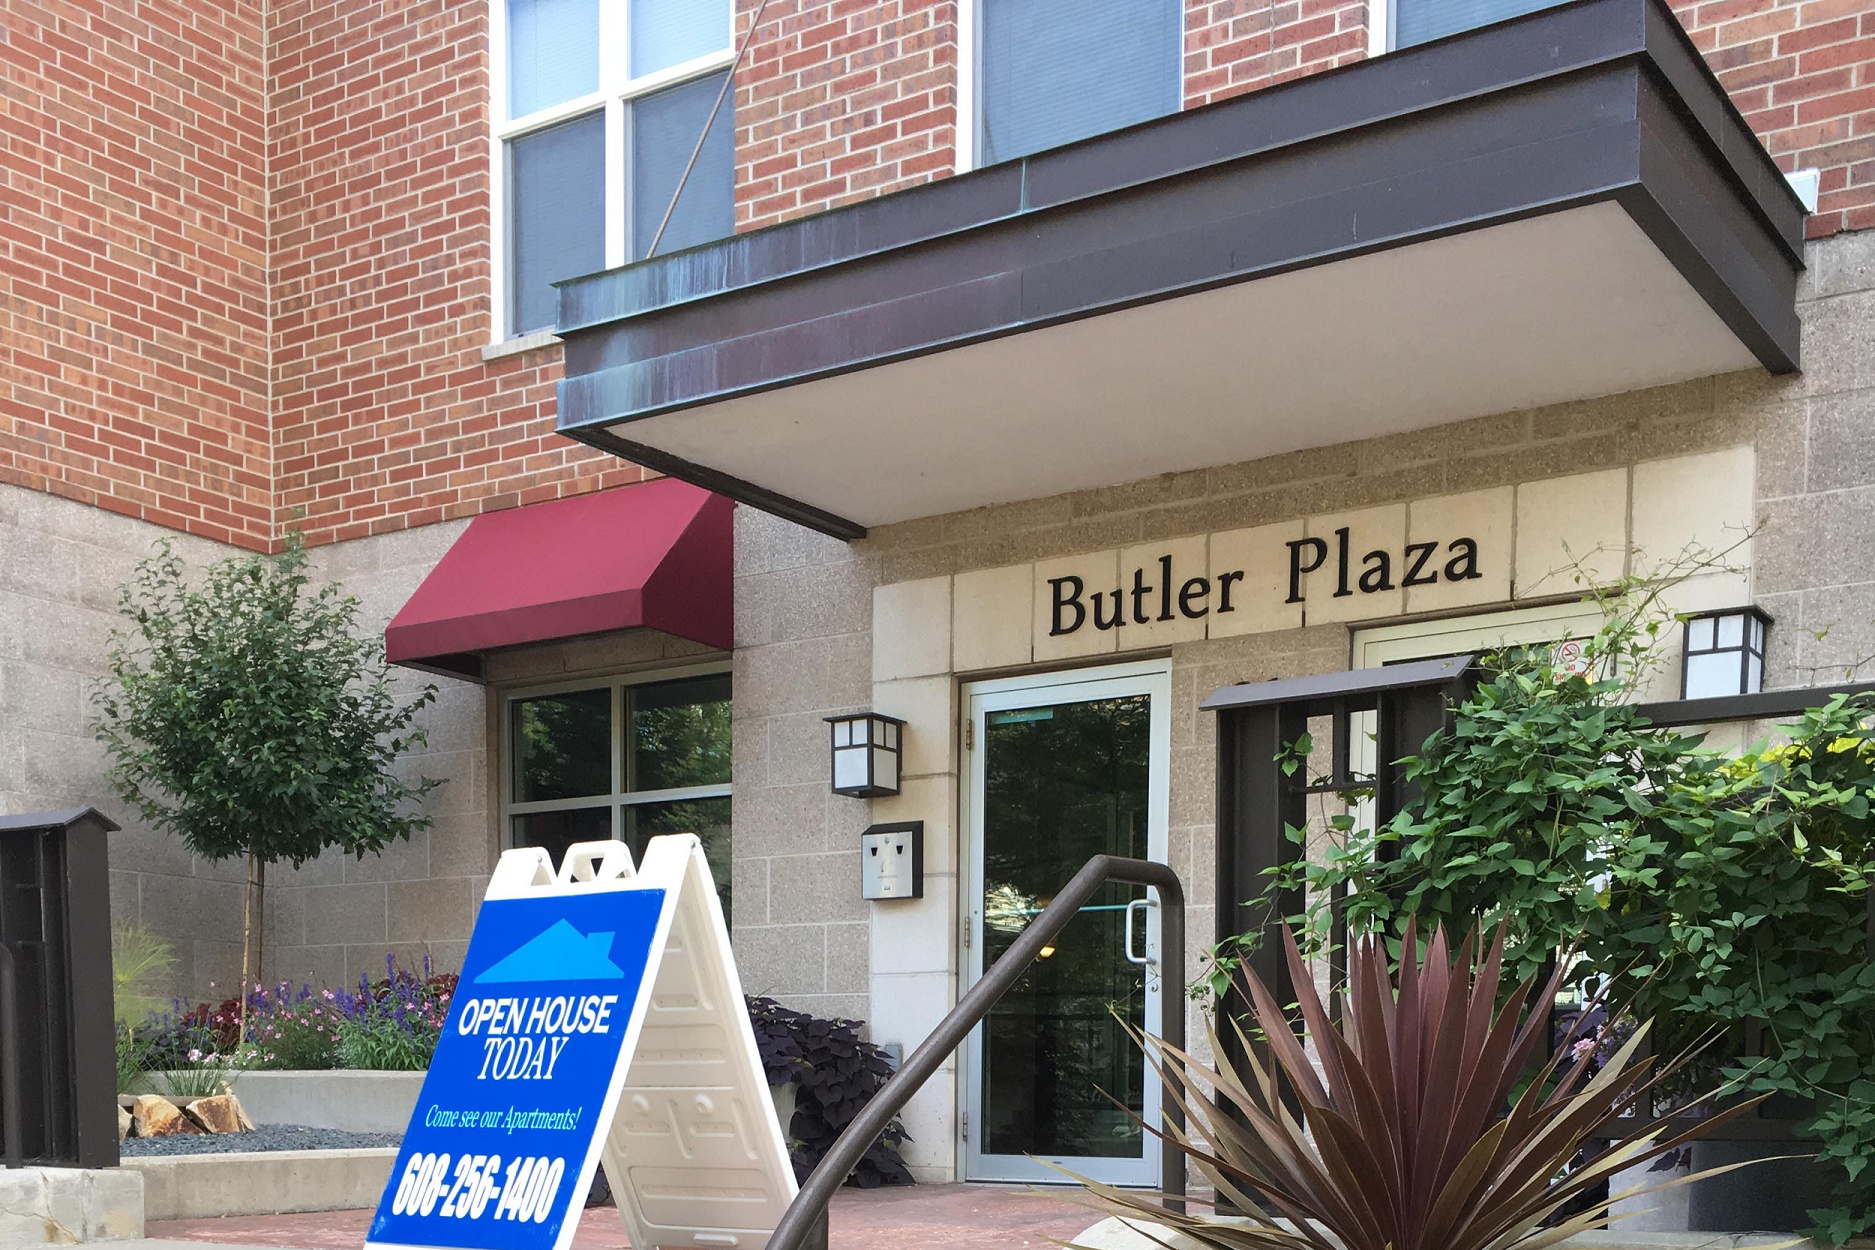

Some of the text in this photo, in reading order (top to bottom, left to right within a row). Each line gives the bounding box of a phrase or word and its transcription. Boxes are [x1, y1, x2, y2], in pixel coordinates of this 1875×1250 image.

[1047, 527, 1483, 637] Butler Plaza
[458, 994, 619, 1036] OPEN HOUSE
[477, 1036, 569, 1080] TODAY
[425, 1104, 583, 1135] Come see our Apartments!
[392, 1152, 566, 1224] 608-256-1400
